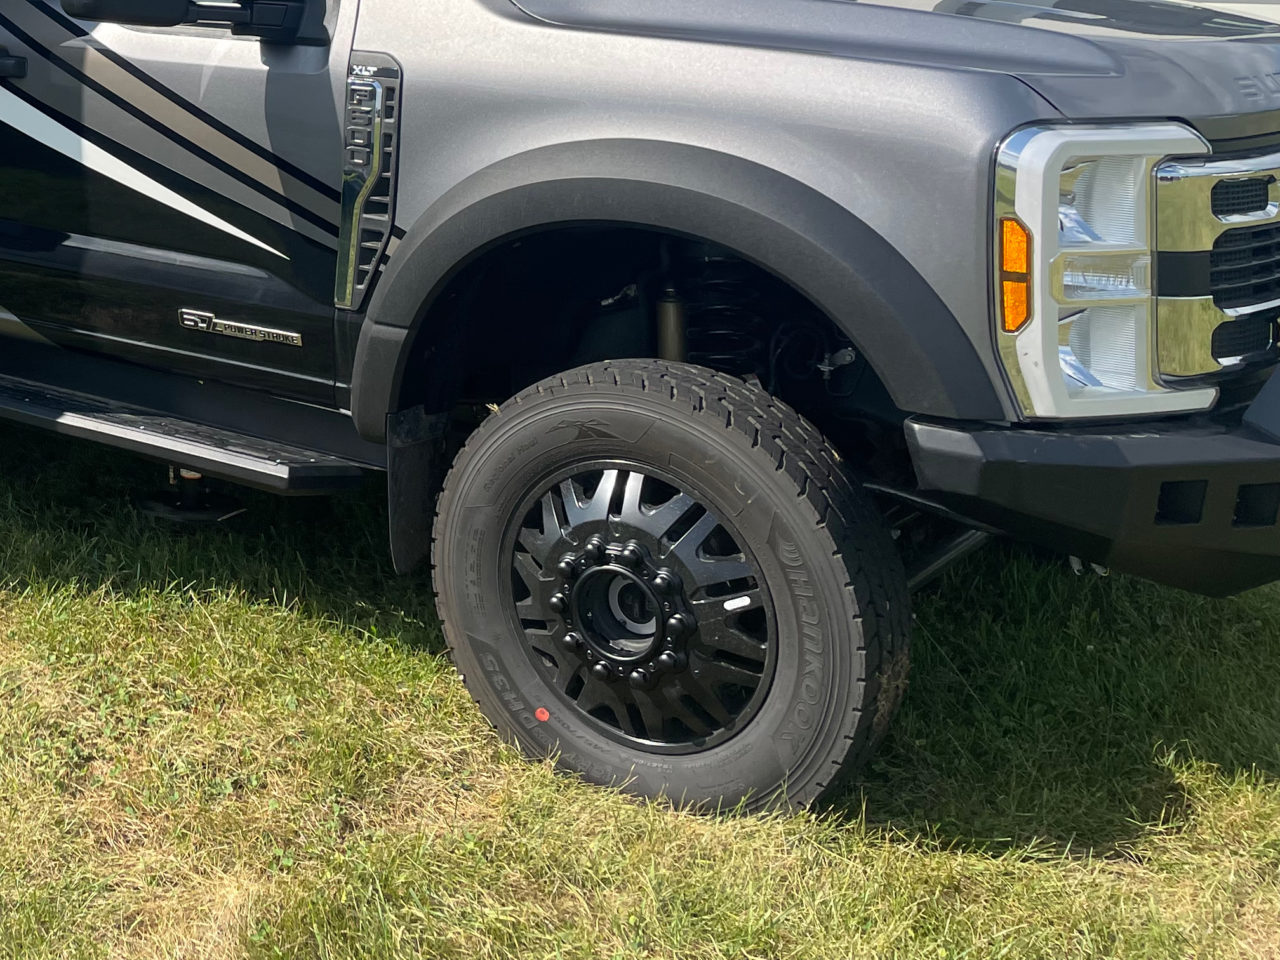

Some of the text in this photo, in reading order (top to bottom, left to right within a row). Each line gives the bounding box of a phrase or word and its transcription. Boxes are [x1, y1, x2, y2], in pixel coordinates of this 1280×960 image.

[352, 64, 377, 76] XLT
[223, 323, 258, 338] POWER
[259, 330, 299, 346] STROKE
